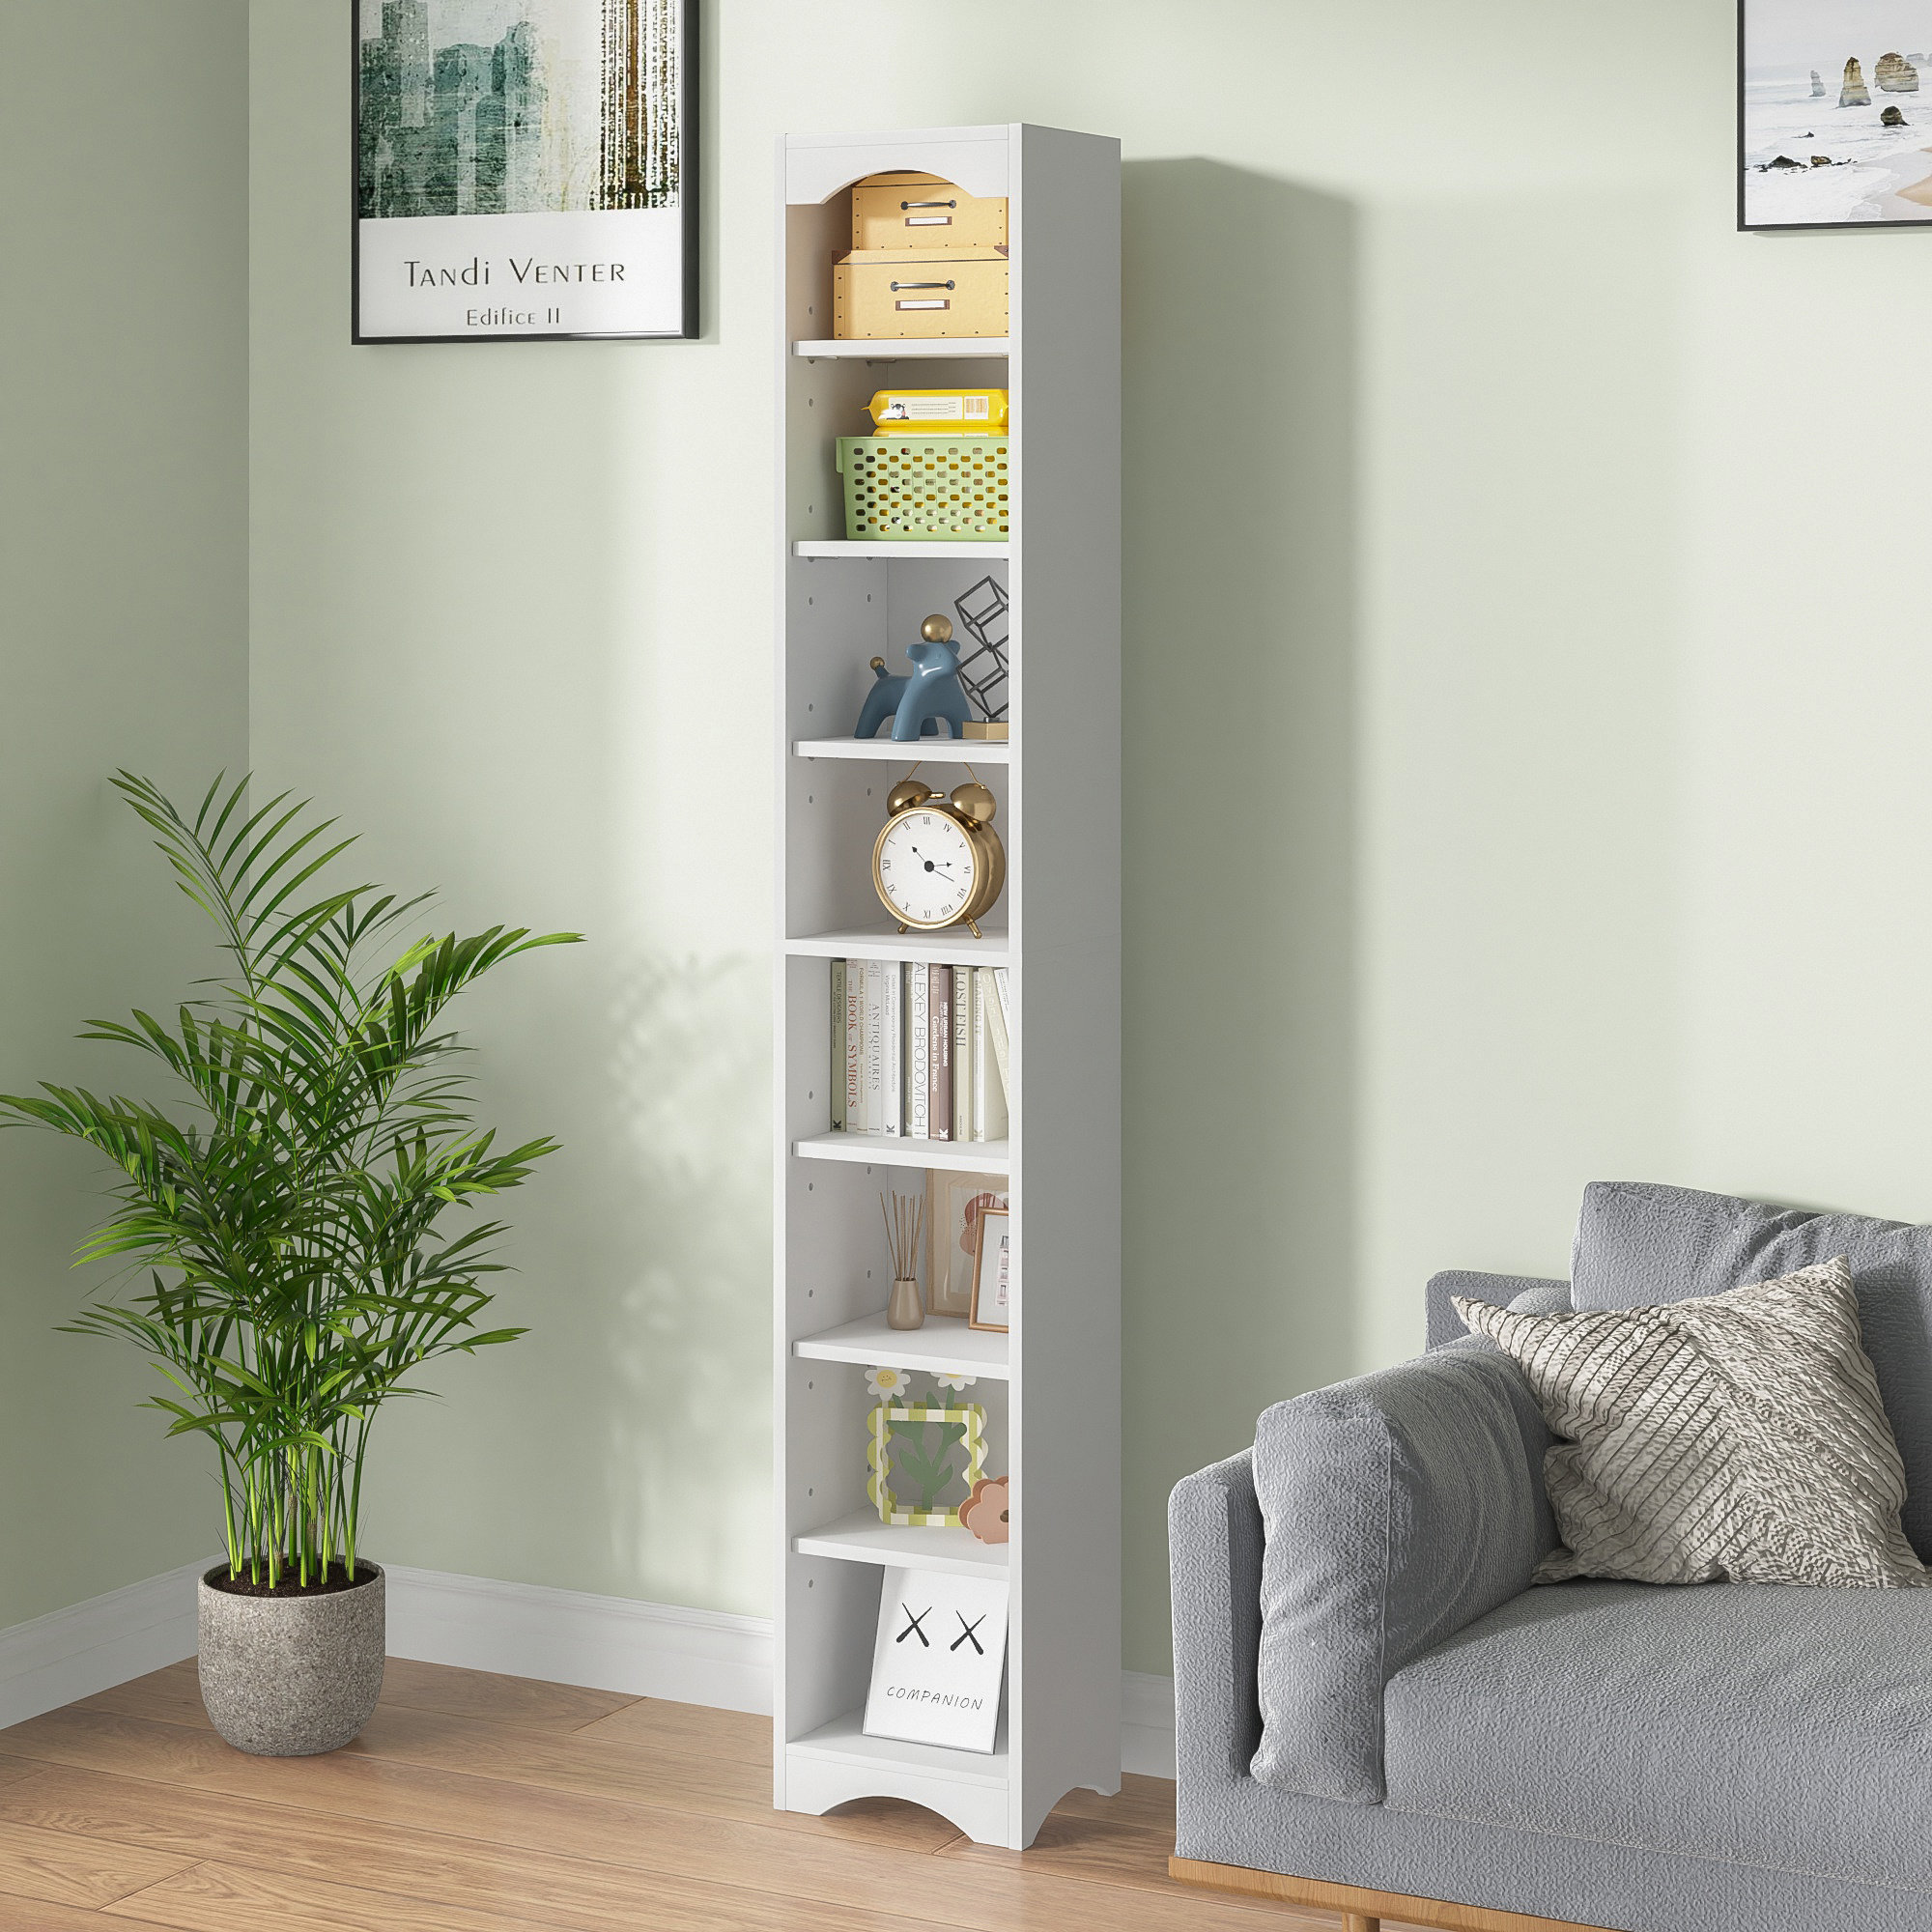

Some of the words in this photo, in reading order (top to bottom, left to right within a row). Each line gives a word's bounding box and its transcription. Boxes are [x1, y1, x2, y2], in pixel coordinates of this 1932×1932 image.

[914, 962, 926, 1023] ALEXEY
[955, 972, 966, 1010] LOST
[847, 995, 857, 1032] BOOK
[955, 1013, 966, 1047] FISH
[870, 1004, 880, 1091] ANTIQUAIRES
[931, 1052, 939, 1062] in
[847, 1044, 857, 1108] SYMBOLS
[914, 1027, 926, 1127] BRODOVITCH
[887, 1686, 984, 1711] COMPANION
